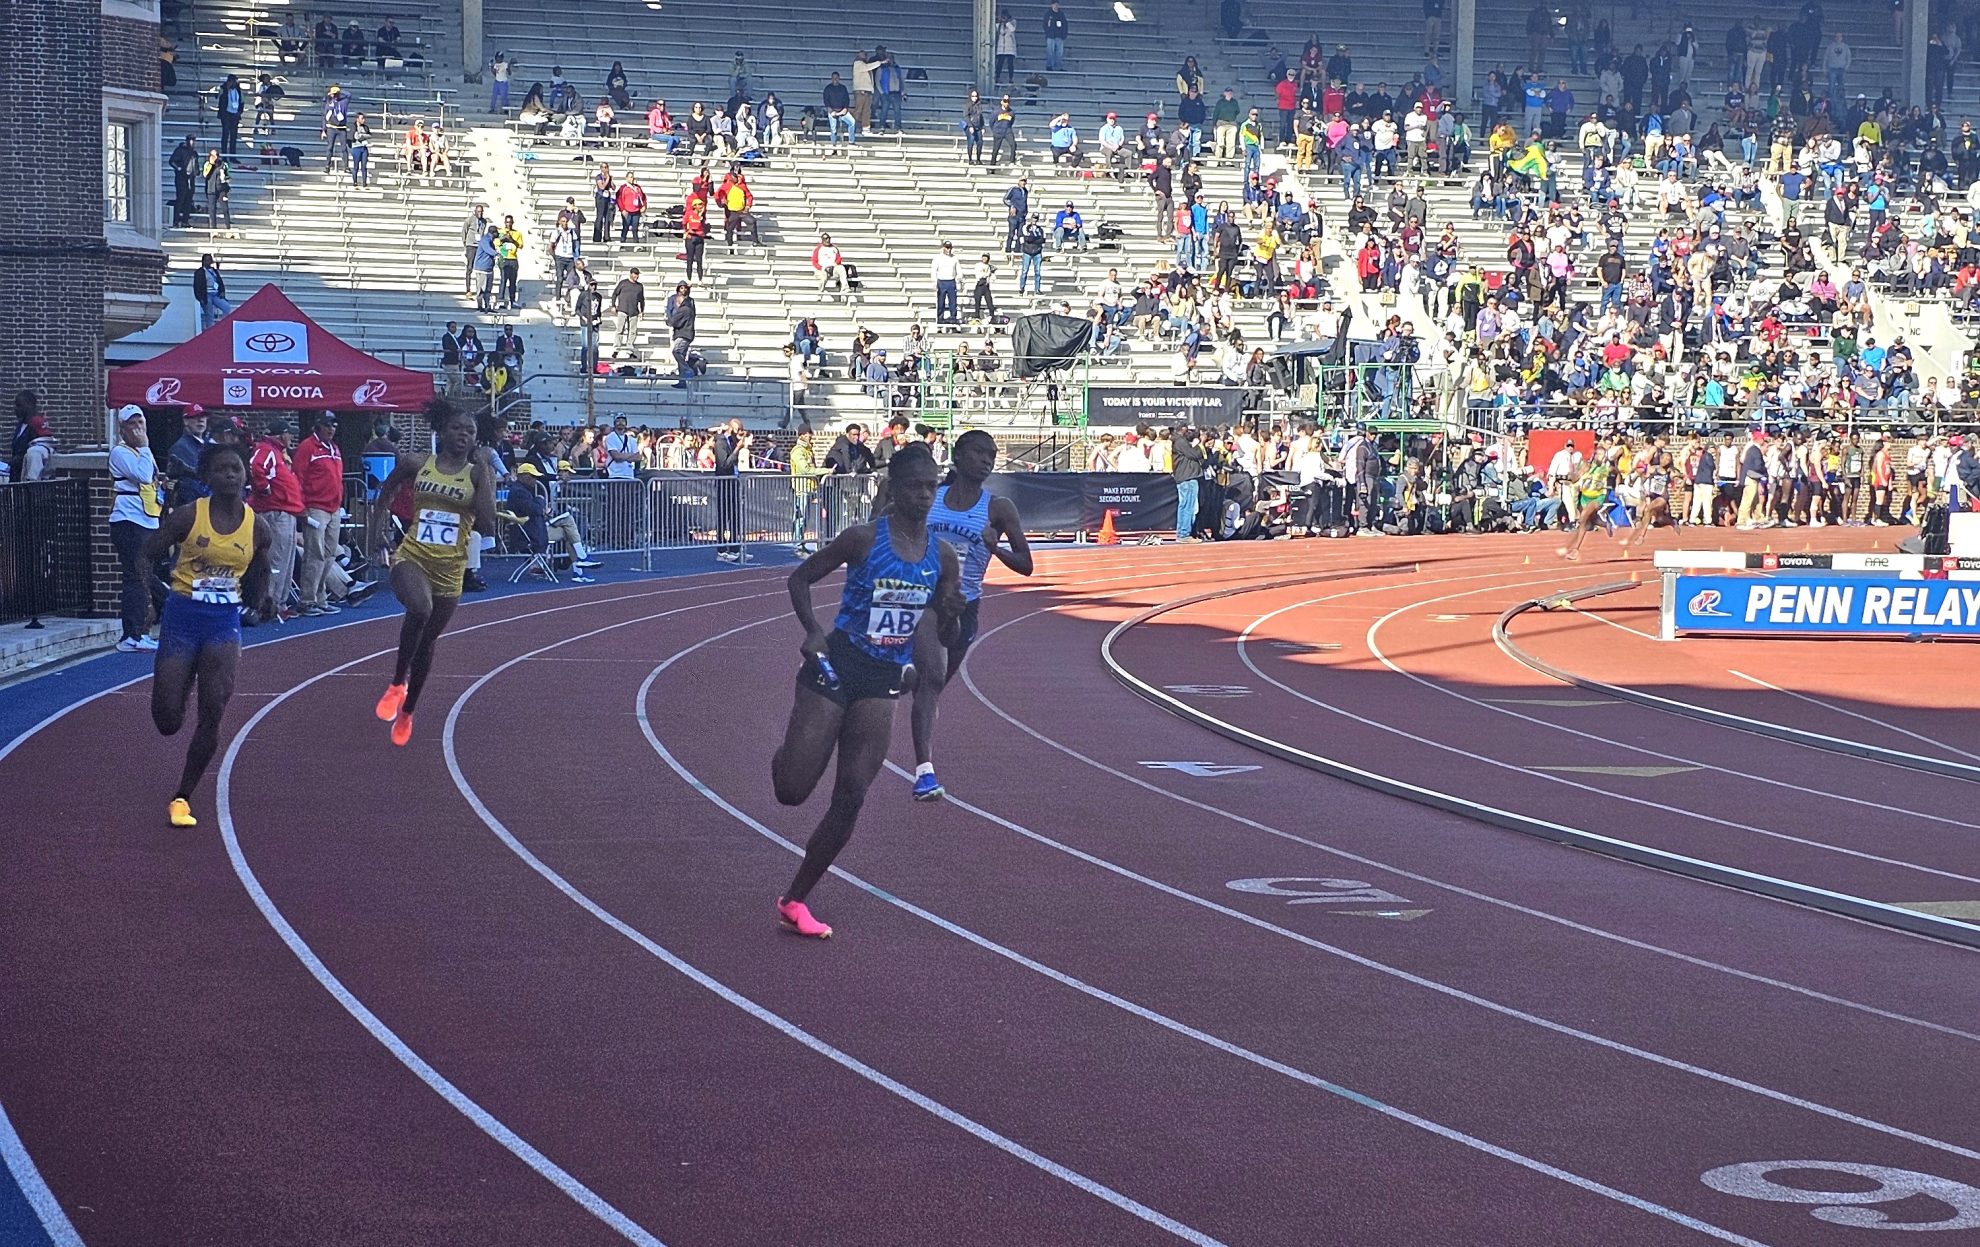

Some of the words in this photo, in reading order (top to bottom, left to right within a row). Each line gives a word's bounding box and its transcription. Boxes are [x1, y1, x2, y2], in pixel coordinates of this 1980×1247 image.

[221, 368, 323, 376] TOYOTA
[258, 385, 324, 399] TOYOTA
[1102, 397, 1131, 407] TODAY
[1132, 397, 1141, 407] IS
[1141, 397, 1166, 407] YOUR
[1166, 397, 1204, 407] VICTORY
[1103, 487, 1119, 495] MAKE
[1119, 487, 1138, 495] EVERY
[670, 495, 708, 506] TIMEX
[1099, 495, 1121, 503] SECOND
[1779, 556, 1814, 567] TOYOTA
[1744, 585, 1854, 625] PENN
[1861, 587, 1980, 627] RELAY
[874, 610, 916, 635] AB
[883, 636, 908, 645] TOYO
[1224, 877, 1414, 904] 5
